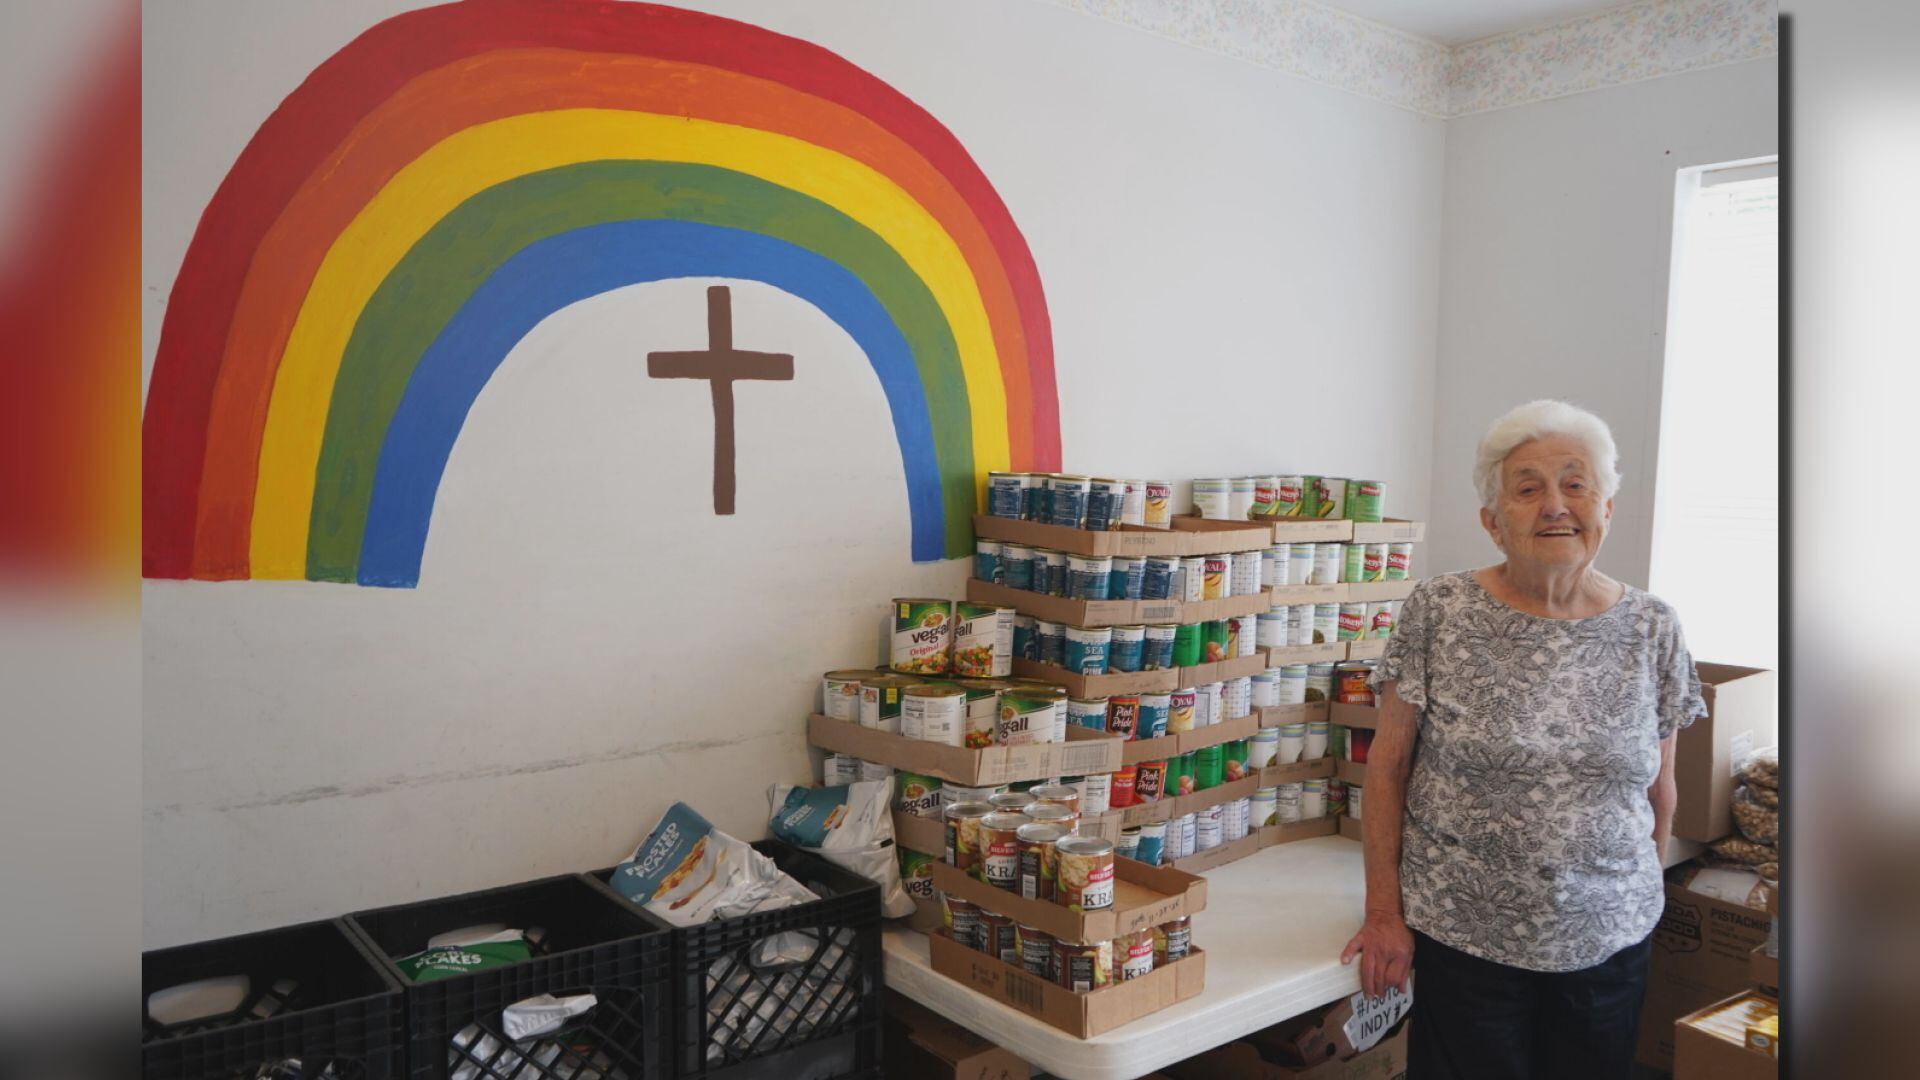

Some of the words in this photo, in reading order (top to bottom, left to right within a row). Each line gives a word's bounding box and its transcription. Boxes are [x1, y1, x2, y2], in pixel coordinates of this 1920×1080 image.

[1083, 646, 1105, 655] SEA
[1115, 705, 1134, 717] Pink
[1111, 717, 1133, 728] Pride
[1140, 770, 1159, 783] Pink
[625, 822, 677, 877] FROSTED
[636, 831, 680, 879] FLAKES
[1361, 1007, 1391, 1040] INDY
